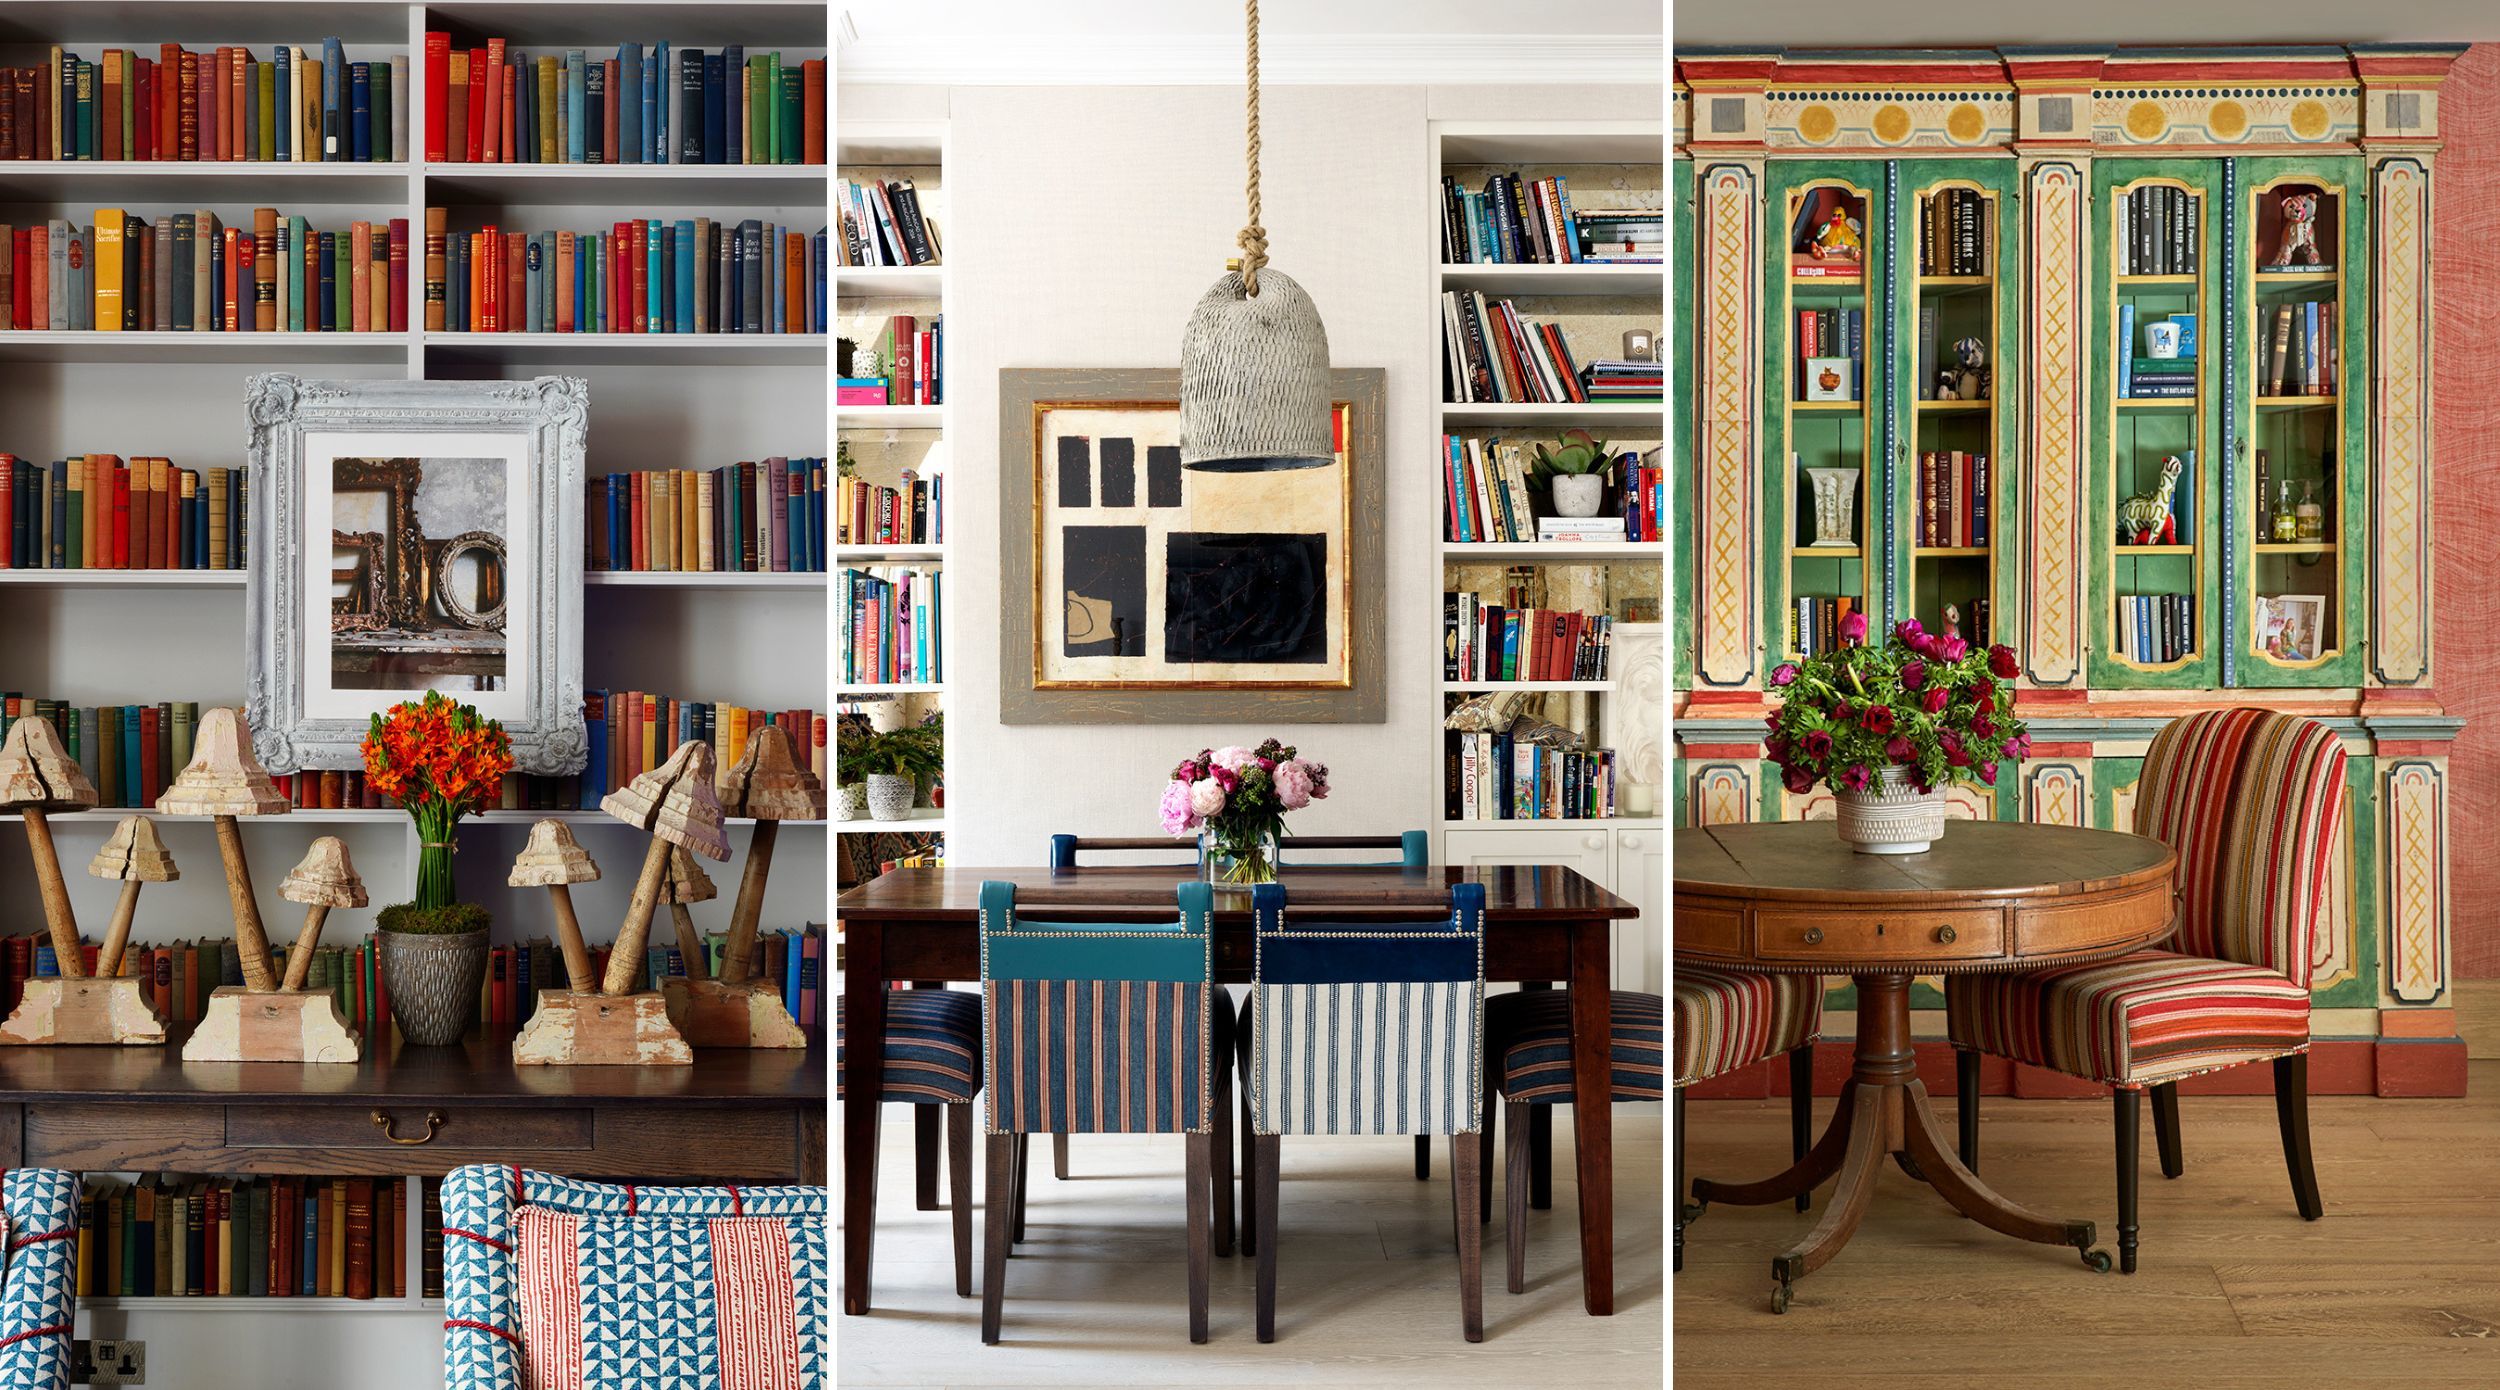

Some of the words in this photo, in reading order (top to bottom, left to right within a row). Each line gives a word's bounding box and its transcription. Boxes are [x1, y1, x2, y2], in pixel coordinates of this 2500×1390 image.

[1494, 177, 1505, 204] BRADLEY
[1546, 178, 1556, 193] TIM
[901, 203, 911, 221] AutoCAD
[911, 213, 921, 233] AutoCAD
[1499, 205, 1510, 232] WIGGINS
[1549, 193, 1564, 236] STOCKDALE
[1962, 203, 1974, 230] KILLER
[97, 226, 121, 235] Ultimate
[97, 235, 121, 243] Sacrifice
[847, 223, 859, 256] COLD
[1581, 228, 1590, 238] K
[1962, 232, 1974, 258] LOOKS
[1463, 292, 1474, 310] KIT
[1467, 314, 1479, 342] KEMP
[884, 496, 892, 525] OXFORD
[759, 528, 767, 555] frontiers
[868, 630, 878, 655] DICTIONARY
[1464, 756, 1476, 773] Jilly
[1567, 755, 1576, 767] Sue
[1464, 774, 1476, 804] Cooper
[1567, 766, 1576, 789] Grafton
